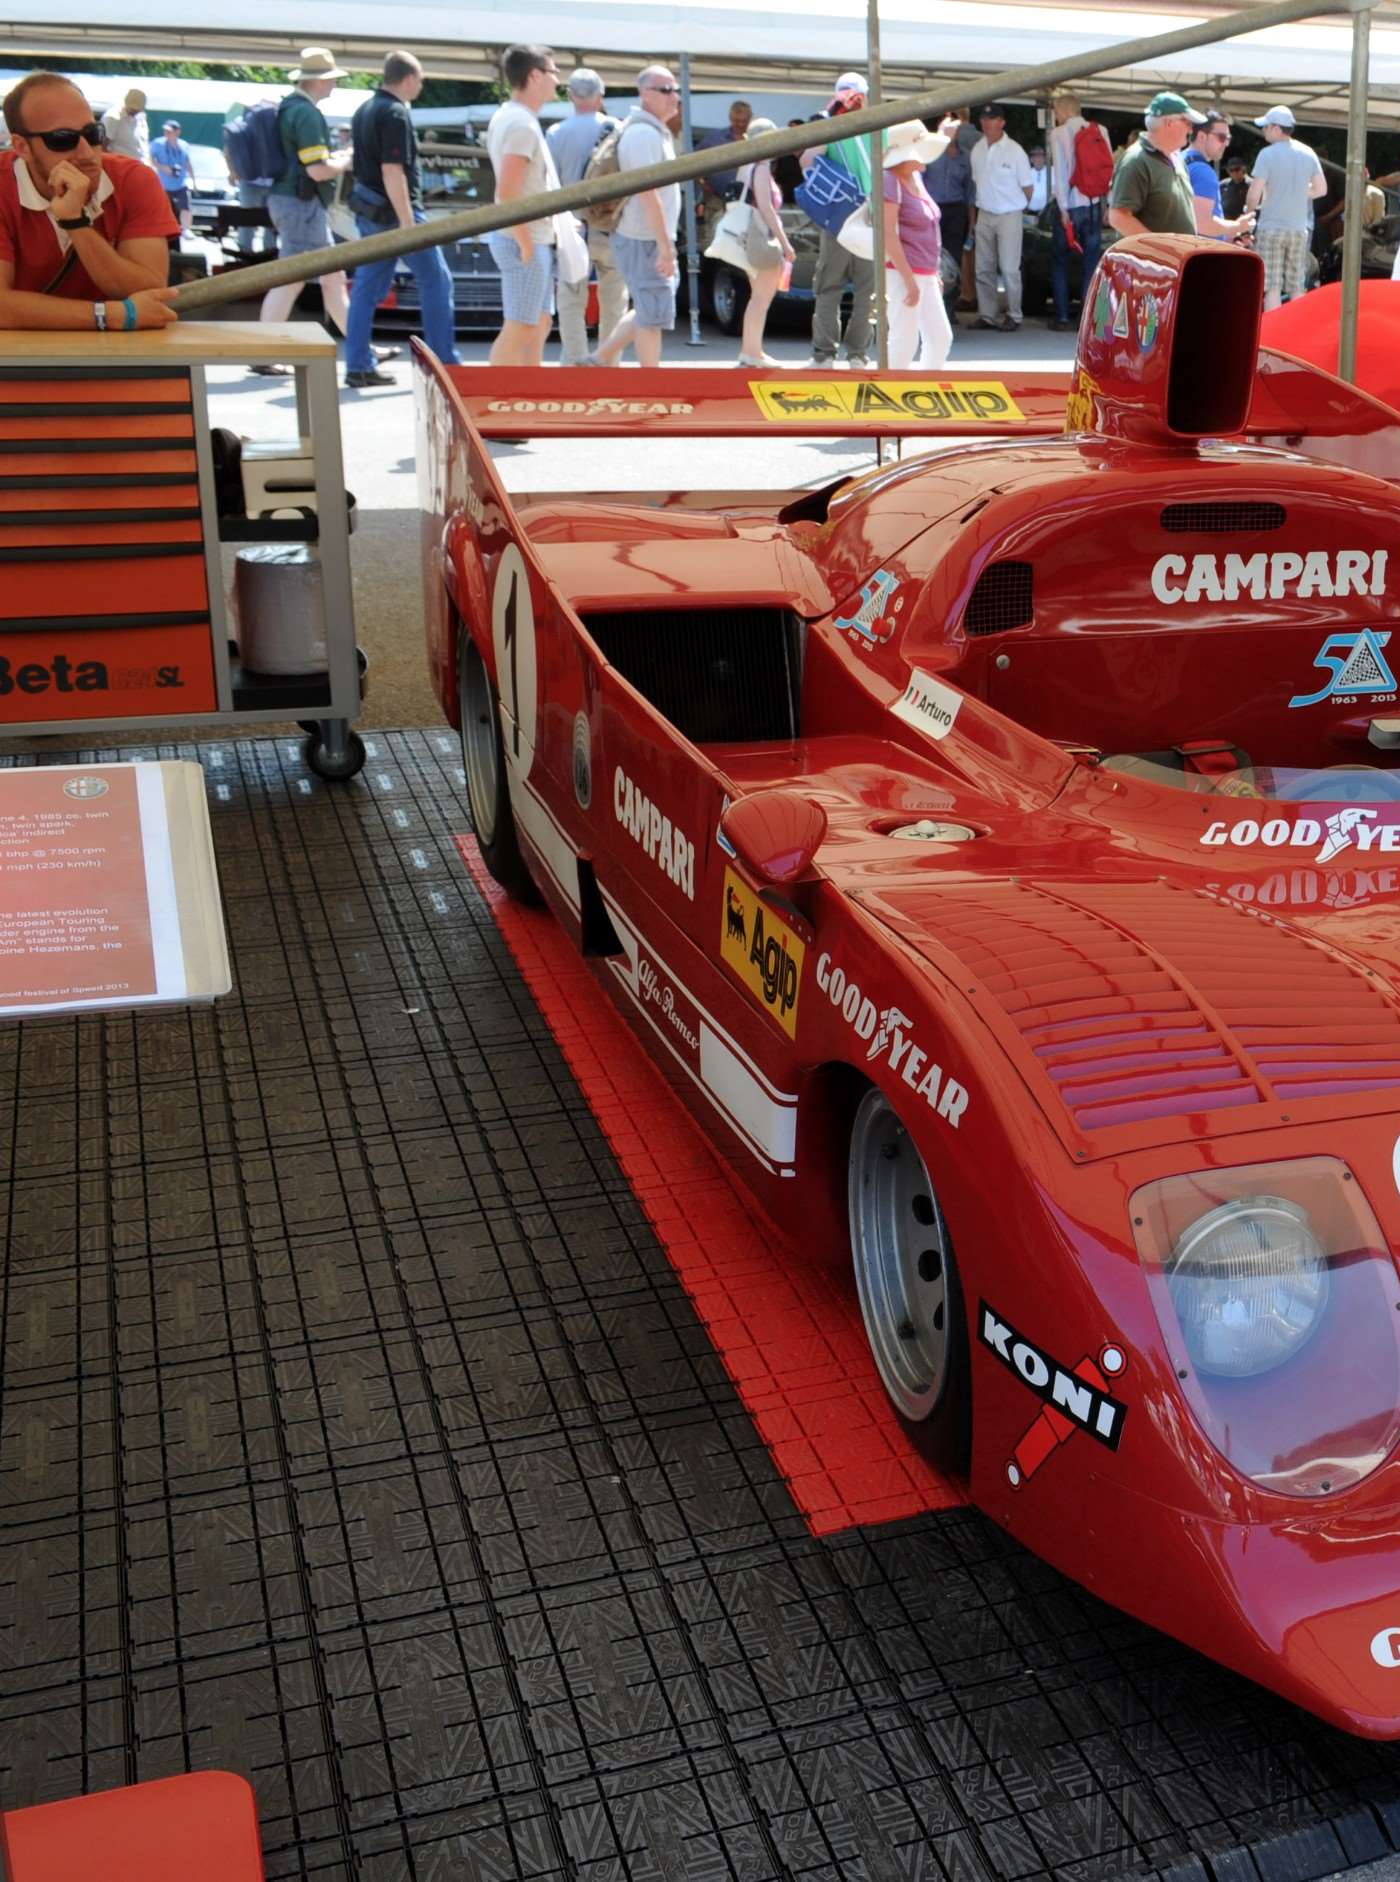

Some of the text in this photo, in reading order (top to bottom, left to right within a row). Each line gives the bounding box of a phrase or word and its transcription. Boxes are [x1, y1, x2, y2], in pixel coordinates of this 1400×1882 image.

[853, 383, 1009, 418] Agip
[1151, 550, 1388, 604] CAMPARI
[505, 569, 520, 758] 1
[918, 695, 952, 727] Arturo
[1331, 694, 1397, 704] 1963 2013
[614, 766, 695, 901] CAMPARI
[1200, 819, 1321, 846] GOOD
[16, 910, 51, 919] latest
[53, 907, 108, 917] evolution
[23, 928, 65, 938] engine
[68, 926, 97, 934] from
[100, 923, 120, 932] the
[25, 936, 67, 944] stands
[70, 934, 87, 943] for
[103, 941, 123, 950] the
[751, 906, 798, 1016] Agip
[815, 952, 969, 1129] GOOD YEAR
[983, 1310, 1116, 1438] KONI
